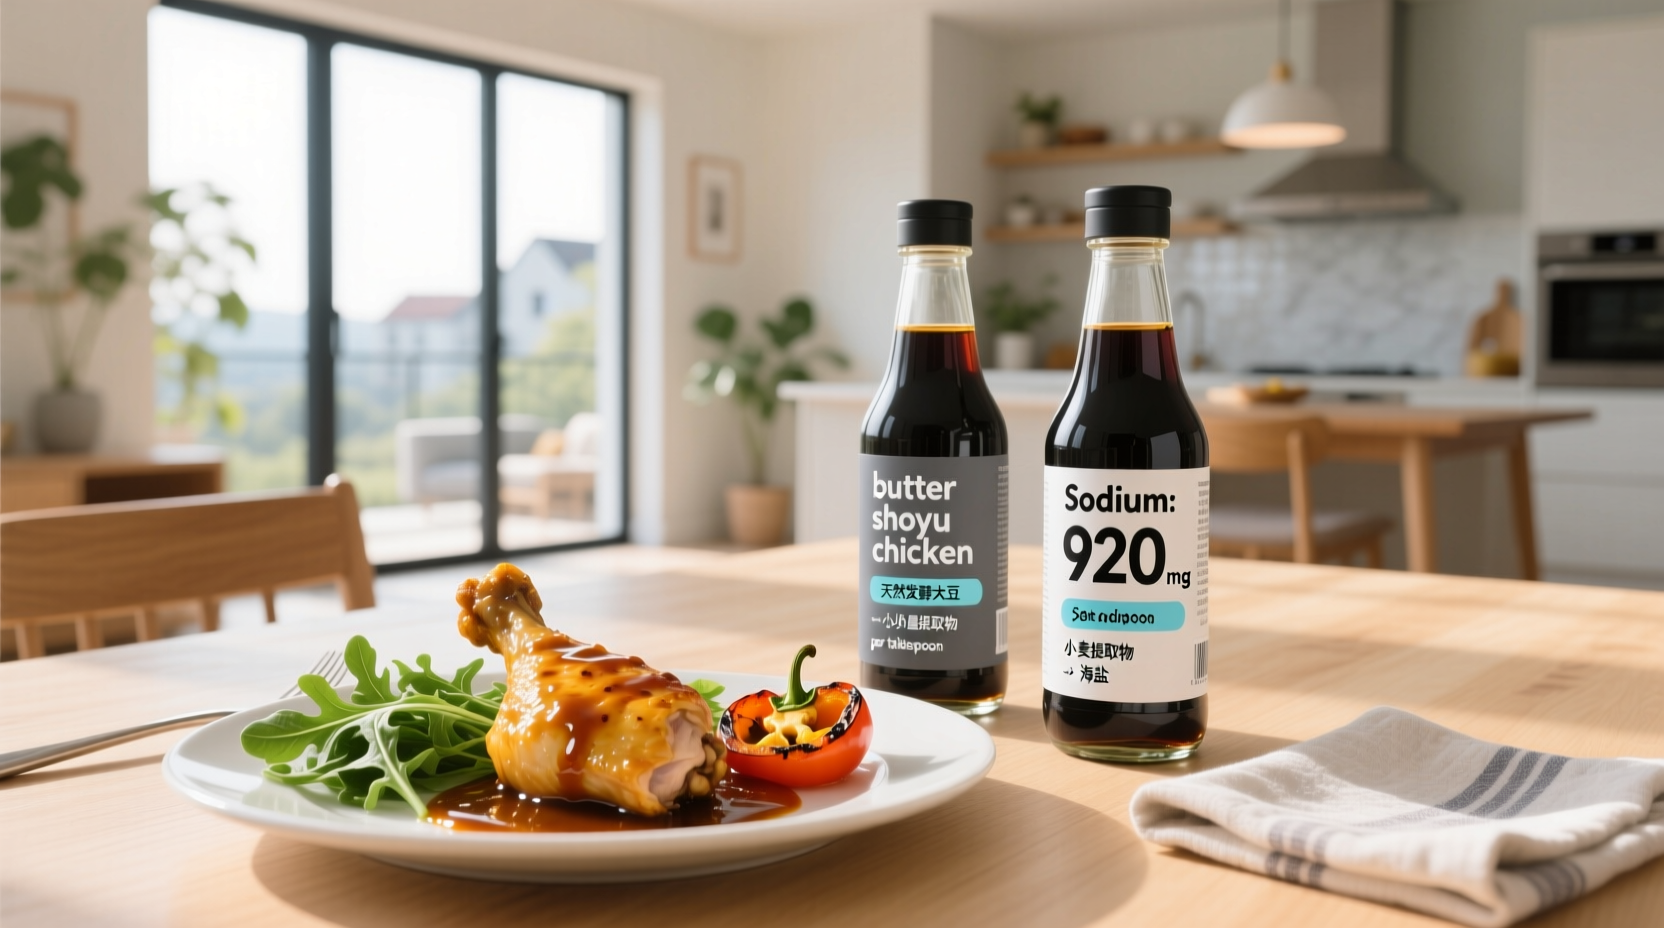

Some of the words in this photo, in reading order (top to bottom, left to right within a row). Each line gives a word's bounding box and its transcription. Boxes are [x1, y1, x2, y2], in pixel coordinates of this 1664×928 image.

[873, 470, 957, 501] butter
[1065, 483, 1176, 513] Sodium:
[872, 503, 950, 540] shoyu
[872, 535, 973, 565] chicken
[1063, 525, 1166, 586] 920
[1166, 571, 1191, 589] mg
